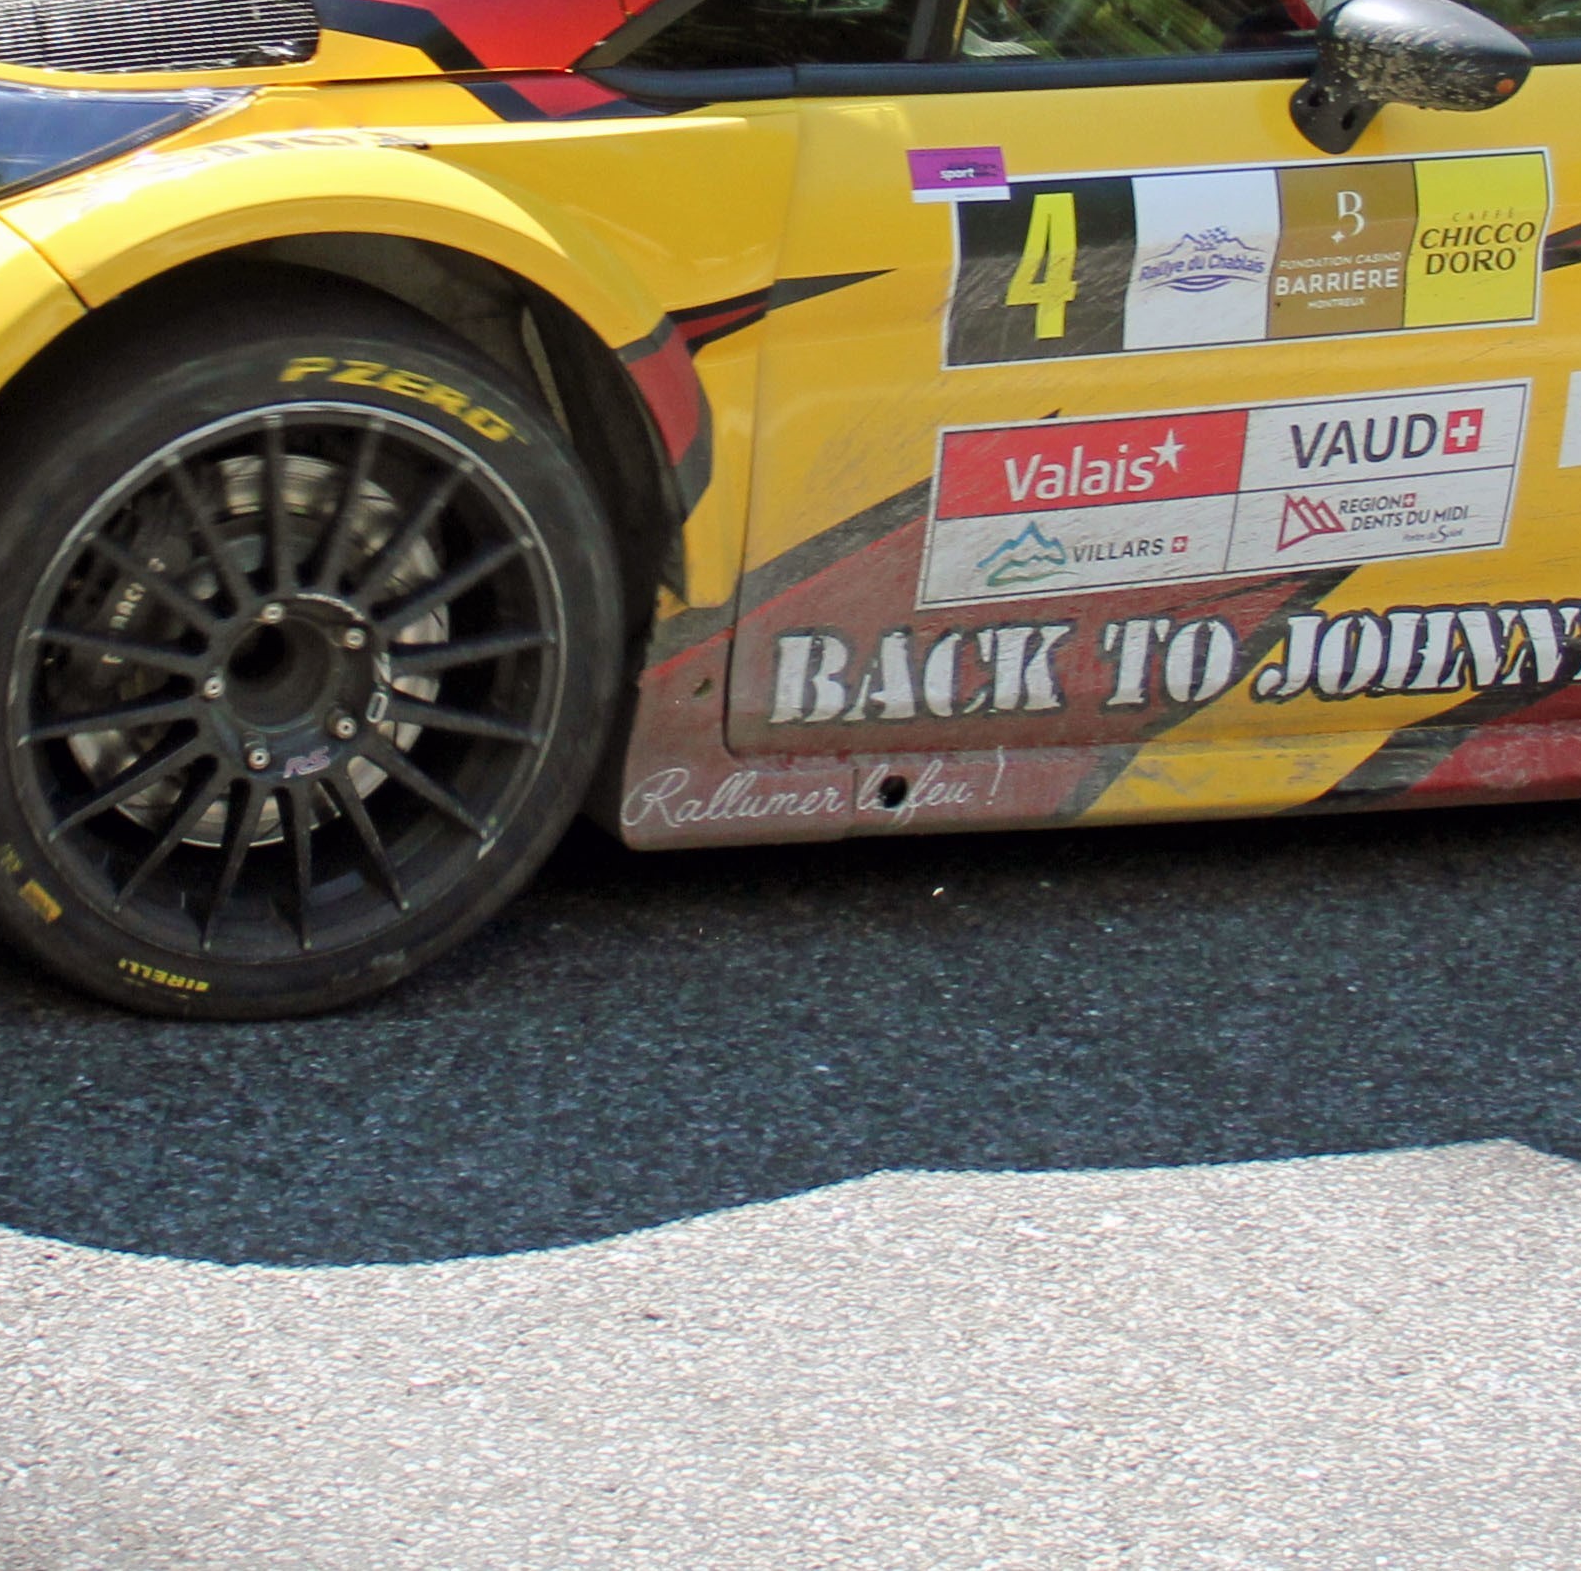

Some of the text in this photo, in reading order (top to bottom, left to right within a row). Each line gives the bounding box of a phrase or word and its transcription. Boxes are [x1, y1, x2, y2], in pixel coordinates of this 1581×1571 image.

[1419, 221, 1536, 249] CHICCO
[1004, 192, 1079, 339] 4
[1139, 252, 1266, 282] Rallye du Chablais
[1279, 254, 1353, 270] FONDATION
[1425, 247, 1517, 276] D'ORO
[1289, 413, 1439, 469] VAUD
[1004, 443, 1157, 503] Valais
[1338, 494, 1403, 515] REGION
[1350, 504, 1470, 531] DENTS DU MIDI
[1072, 537, 1165, 564] VILLARS
[769, 625, 1072, 724] BACK
[1103, 618, 1235, 707] TO
